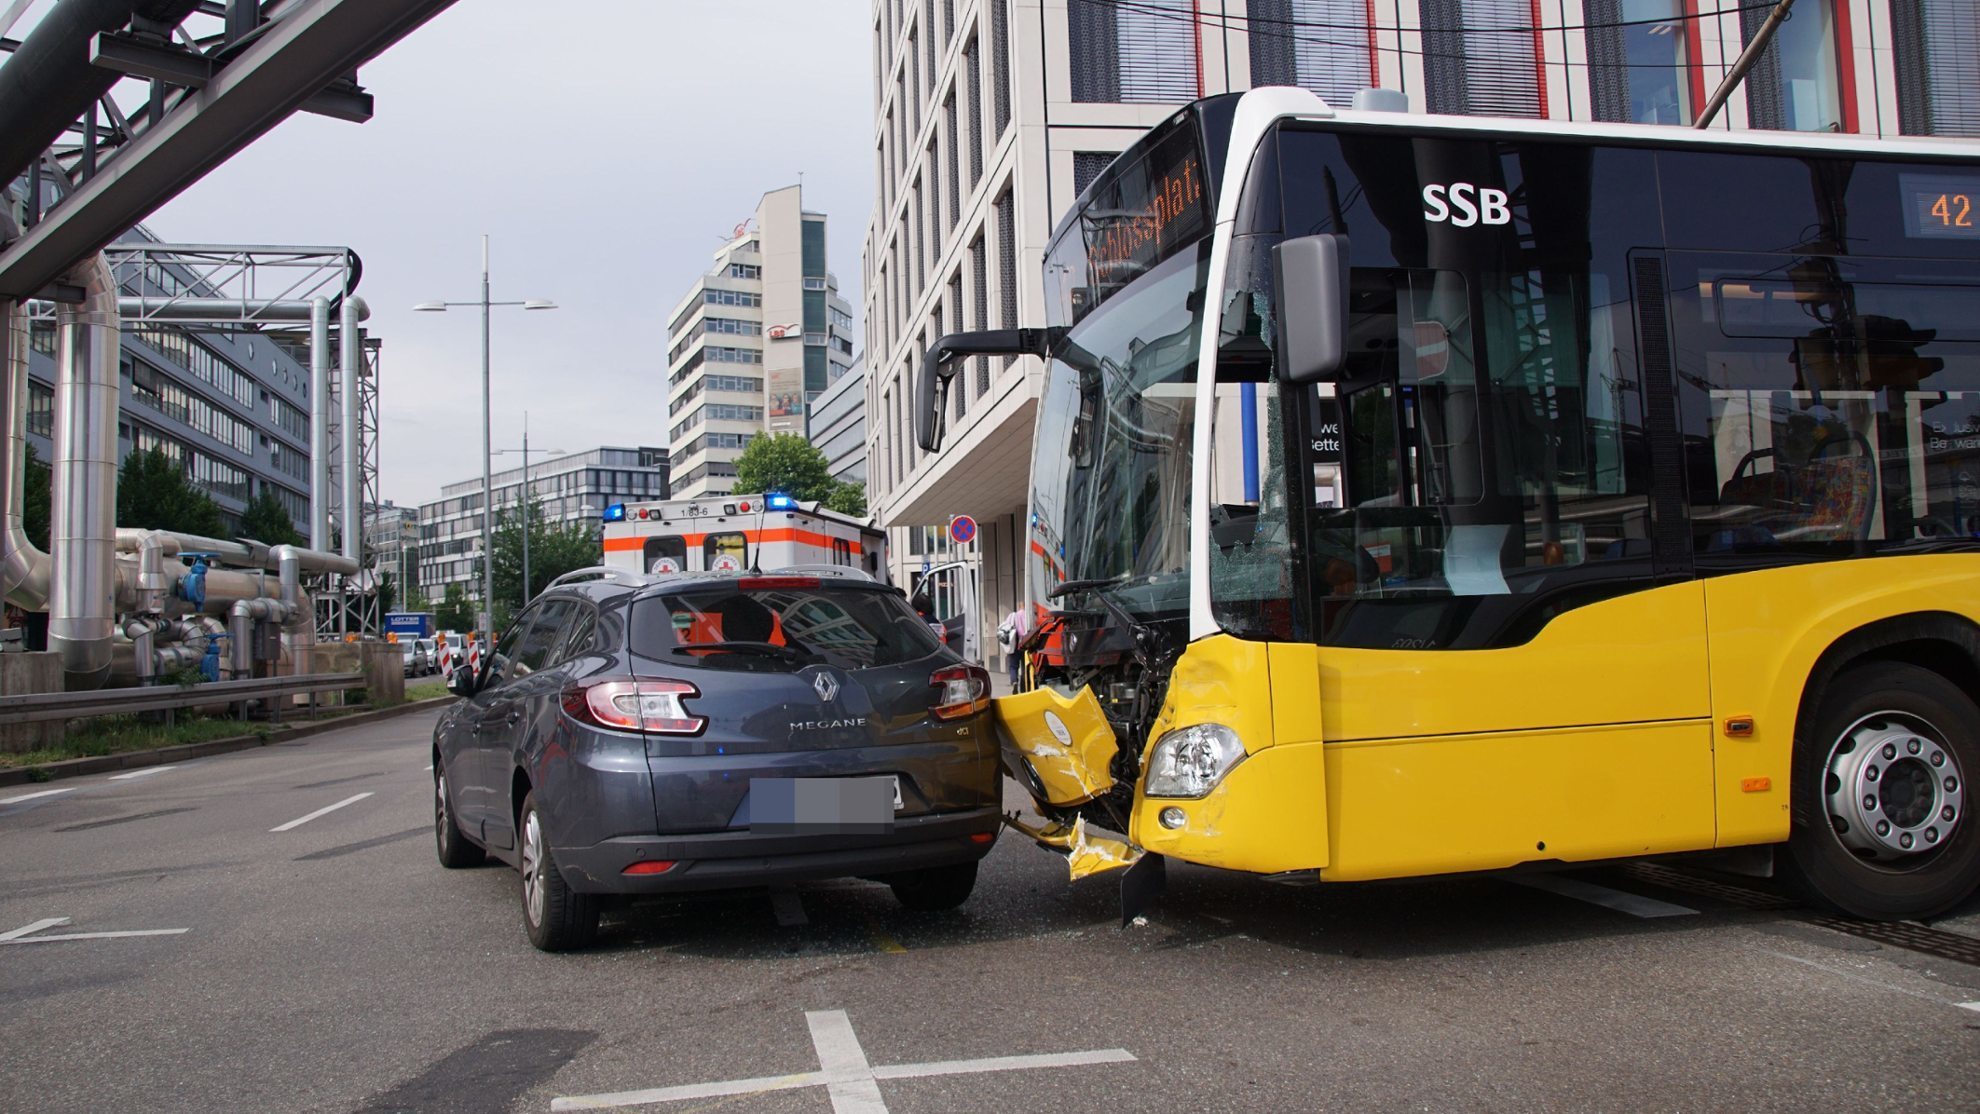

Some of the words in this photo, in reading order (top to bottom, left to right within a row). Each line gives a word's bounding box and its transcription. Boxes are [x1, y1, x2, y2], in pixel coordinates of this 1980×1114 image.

[1422, 182, 1511, 228] SSB
[1931, 194, 1972, 226] 42
[789, 718, 867, 731] MEGANE
